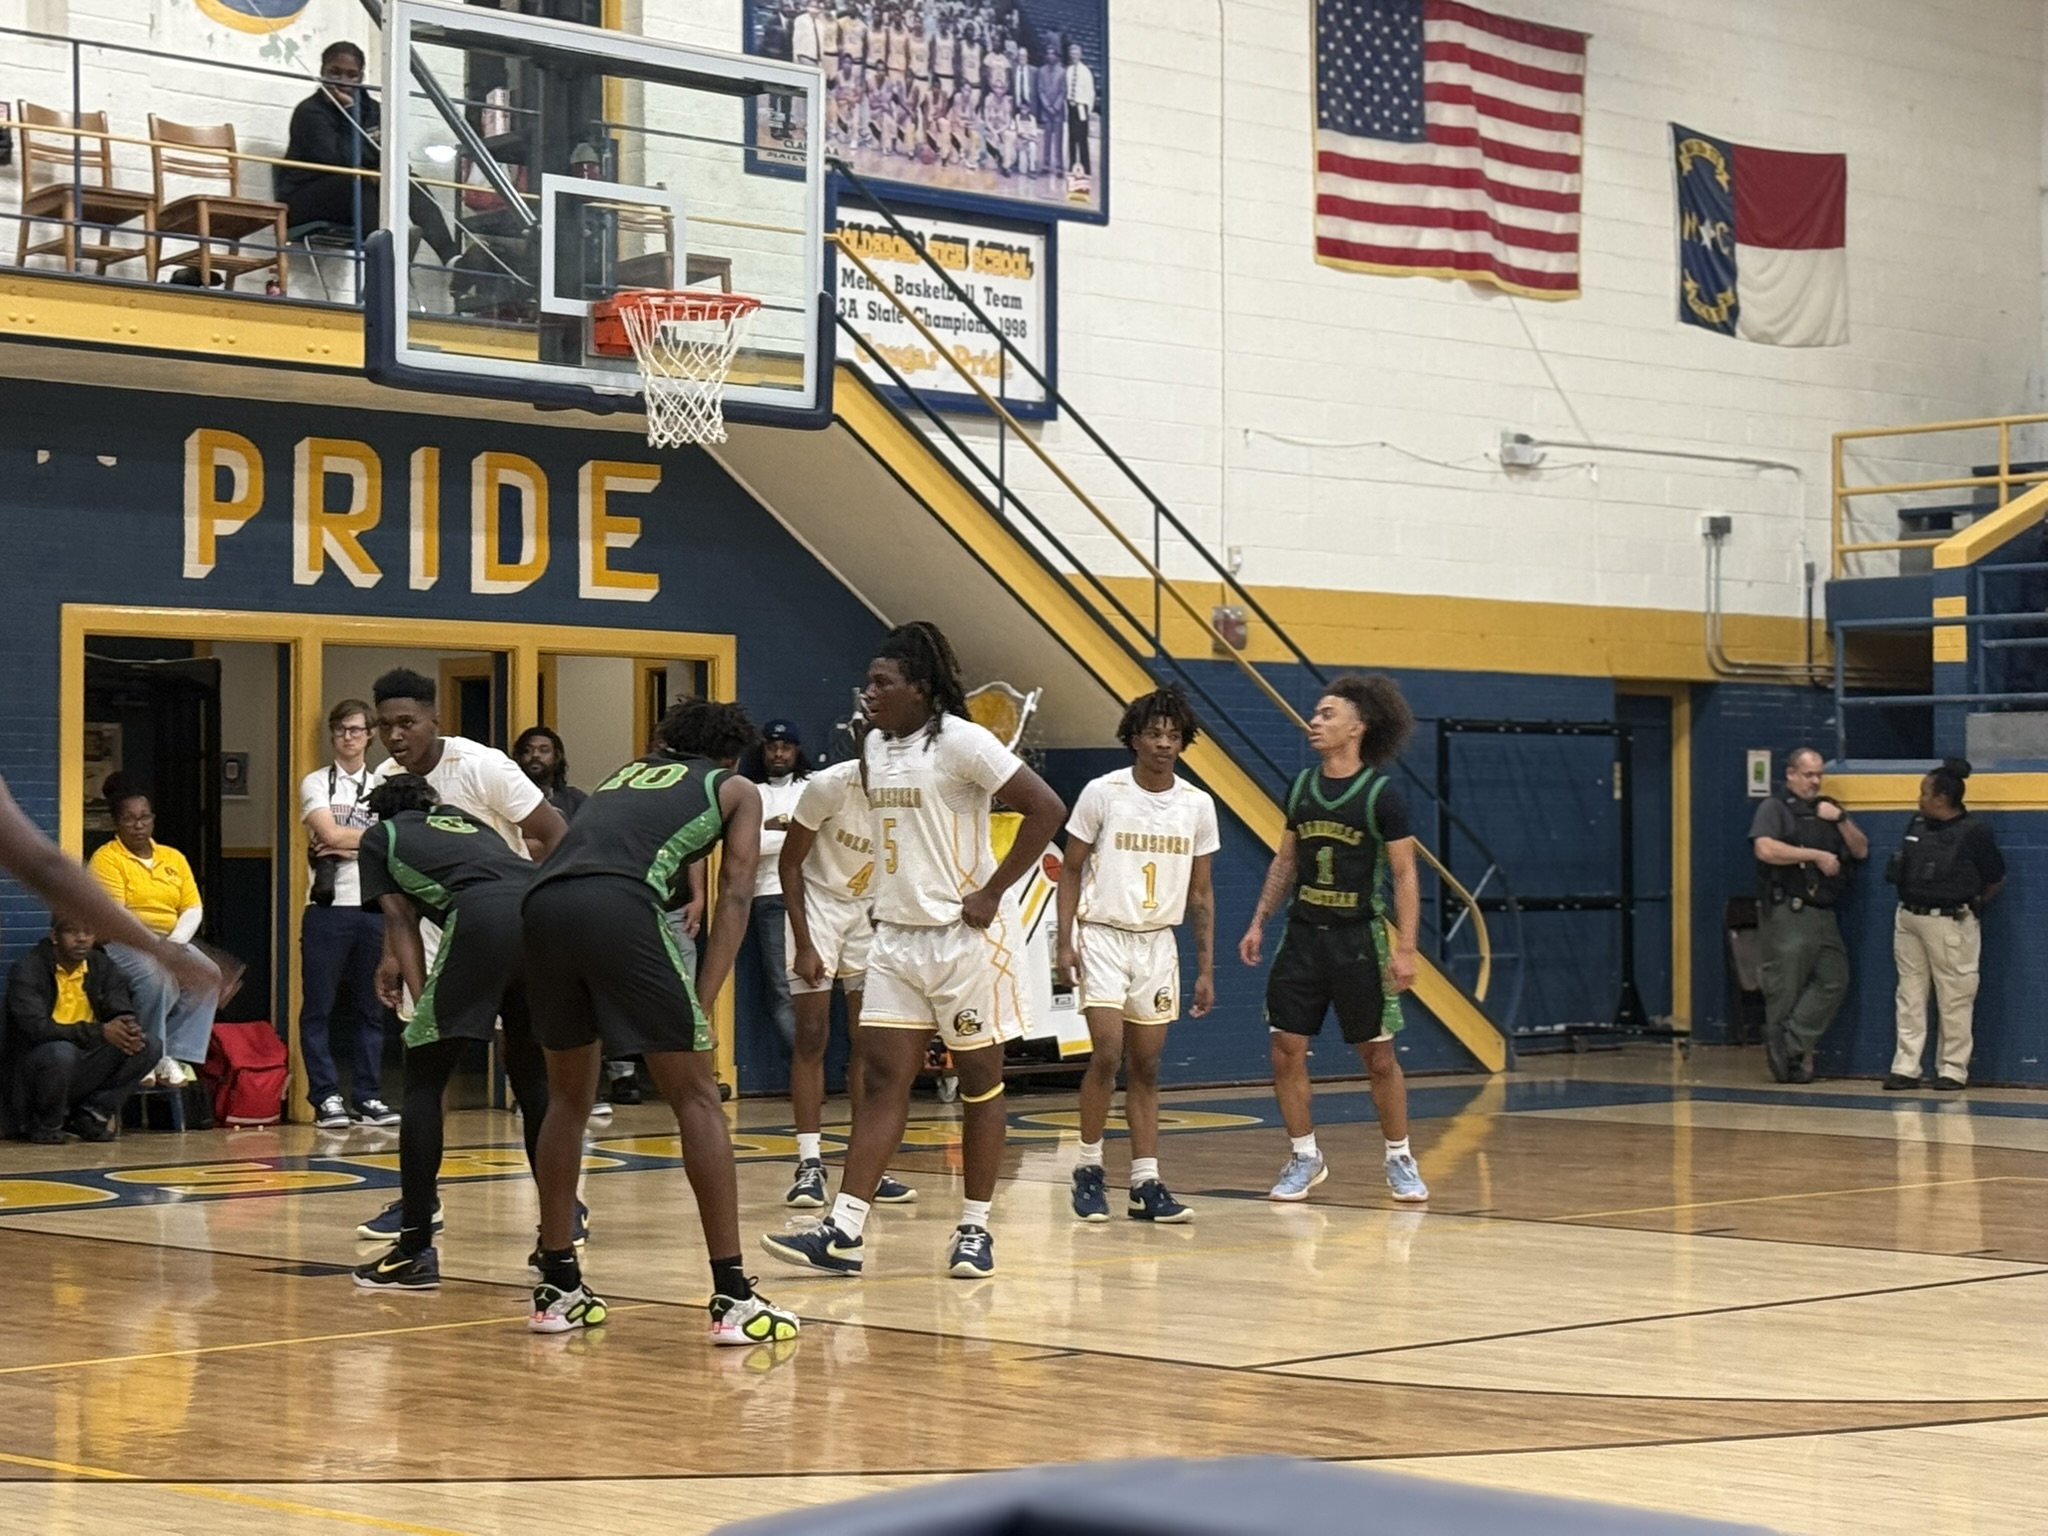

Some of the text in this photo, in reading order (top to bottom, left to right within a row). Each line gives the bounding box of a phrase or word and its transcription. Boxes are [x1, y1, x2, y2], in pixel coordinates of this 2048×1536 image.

[836, 221, 926, 265] OLDSBOR
[972, 240, 1034, 280] SCHOOL
[841, 267, 1022, 310] Men Basketbll Team
[838, 297, 859, 319] 3A
[867, 301, 904, 324] State
[998, 317, 1027, 339] 1998
[183, 427, 662, 602] PRIDE
[597, 762, 690, 793] 10
[882, 817, 898, 875] 5
[1315, 846, 1335, 885] 1
[846, 860, 875, 897] 4
[1141, 861, 1159, 909] 1
